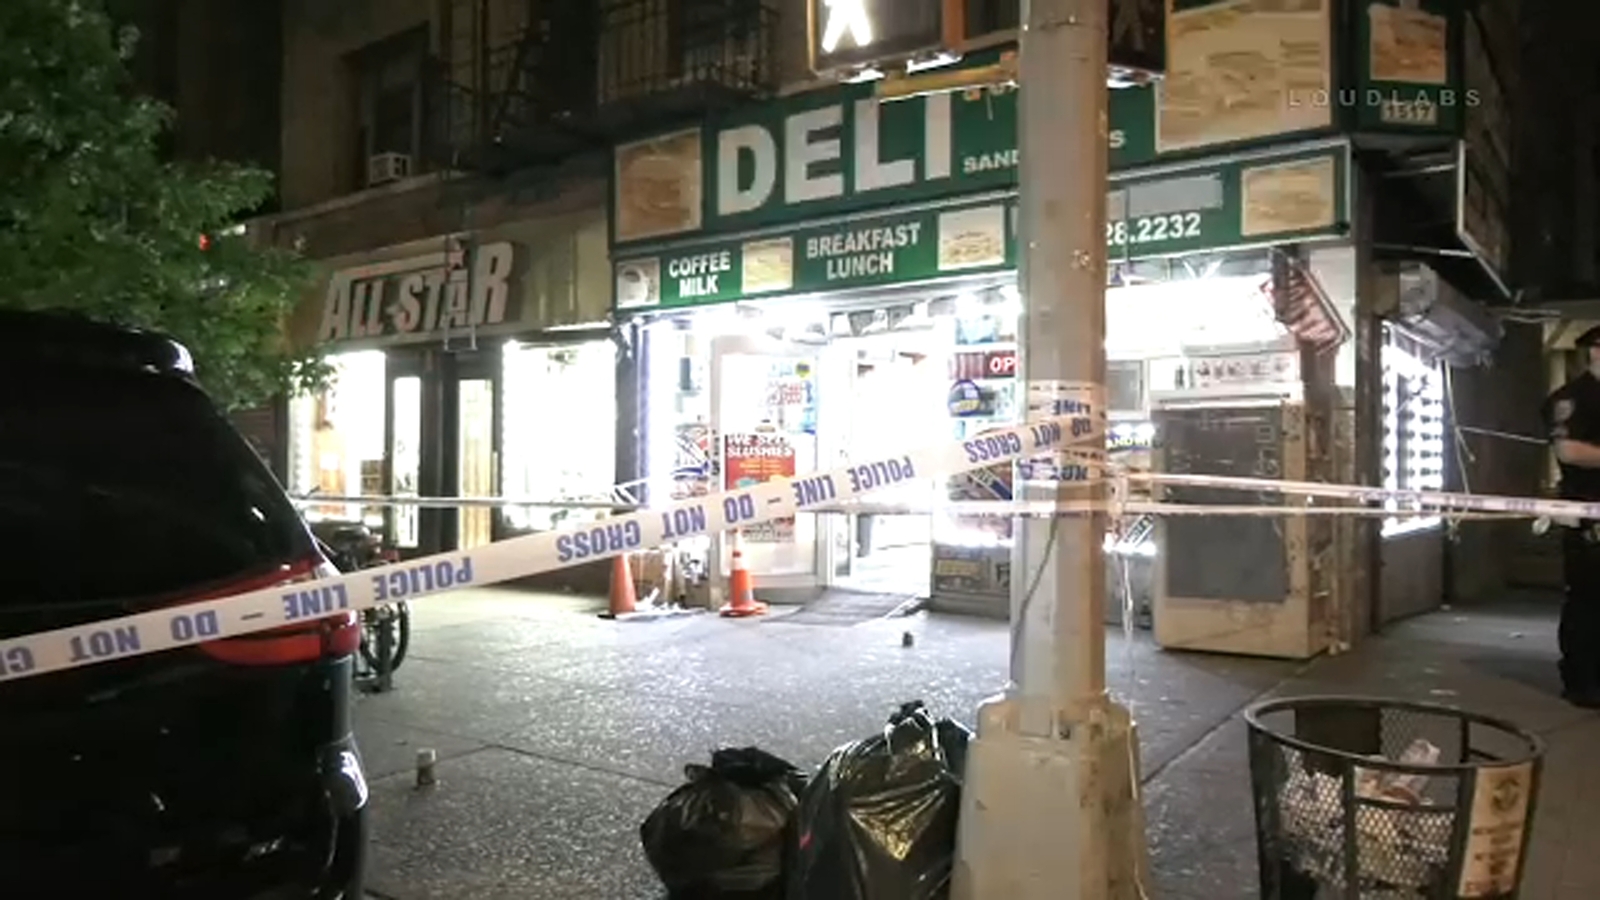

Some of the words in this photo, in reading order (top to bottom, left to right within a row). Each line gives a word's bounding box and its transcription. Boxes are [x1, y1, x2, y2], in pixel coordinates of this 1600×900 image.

[717, 93, 951, 216] DELI
[806, 223, 920, 258] BREAKFAST
[669, 251, 731, 277] COFFEE
[827, 251, 893, 279] LUNCH
[679, 273, 718, 298] MILK
[964, 432, 1021, 463] CROSS
[792, 474, 836, 506] LINE
[849, 456, 915, 492] POLICE
[661, 504, 706, 539] NOT
[723, 494, 754, 523] DO
[556, 520, 641, 562] CROSS
[374, 556, 473, 600] POLICE
[283, 584, 348, 620] LINE
[171, 609, 218, 641] DO
[69, 625, 140, 662] NOT
